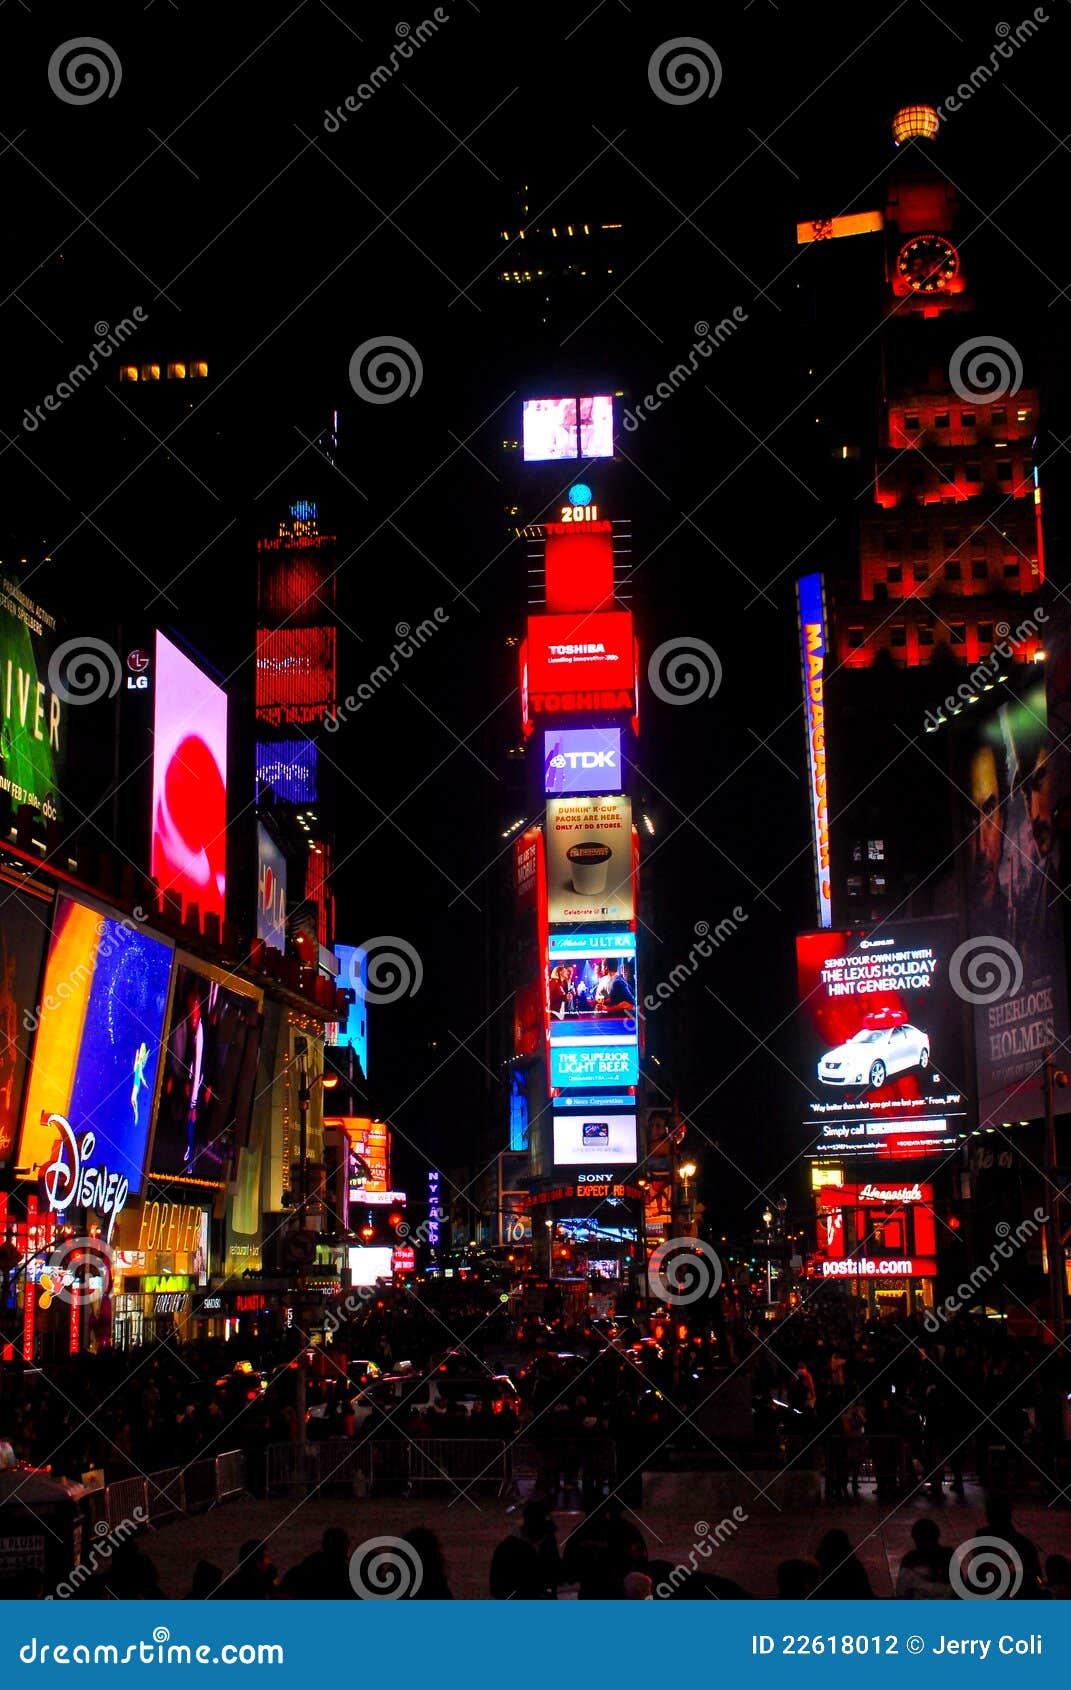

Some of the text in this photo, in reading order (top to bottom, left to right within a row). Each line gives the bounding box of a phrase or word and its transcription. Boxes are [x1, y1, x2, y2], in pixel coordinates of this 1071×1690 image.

[561, 505, 598, 523] 2011
[544, 520, 613, 536] TOSHIBA
[548, 643, 605, 656] TOSHIBA
[127, 676, 148, 690] LG
[531, 691, 633, 713] TOSHIBA
[564, 750, 616, 769] TDK
[42, 799, 57, 821] abc
[555, 815, 581, 823] PACKS
[583, 814, 599, 822] ARE
[589, 935, 631, 947] ULTRA
[824, 949, 933, 969] SEND YOUR OWN HINT WITH
[821, 959, 937, 983] THE LEXUS HOLIDAY
[828, 974, 931, 997] HINT GENERATOR
[988, 987, 1054, 1030] SHERLOCK
[989, 1015, 1056, 1062] HOLMES
[558, 1052, 630, 1063] THE SUPERIOR
[558, 1061, 630, 1074] LIGHT BEER
[823, 1125, 850, 1138] Simply
[850, 1123, 865, 1135] call
[577, 1174, 614, 1183] SONY
[576, 1184, 609, 1197] EXPECT
[138, 1201, 203, 1252] FOREVER
